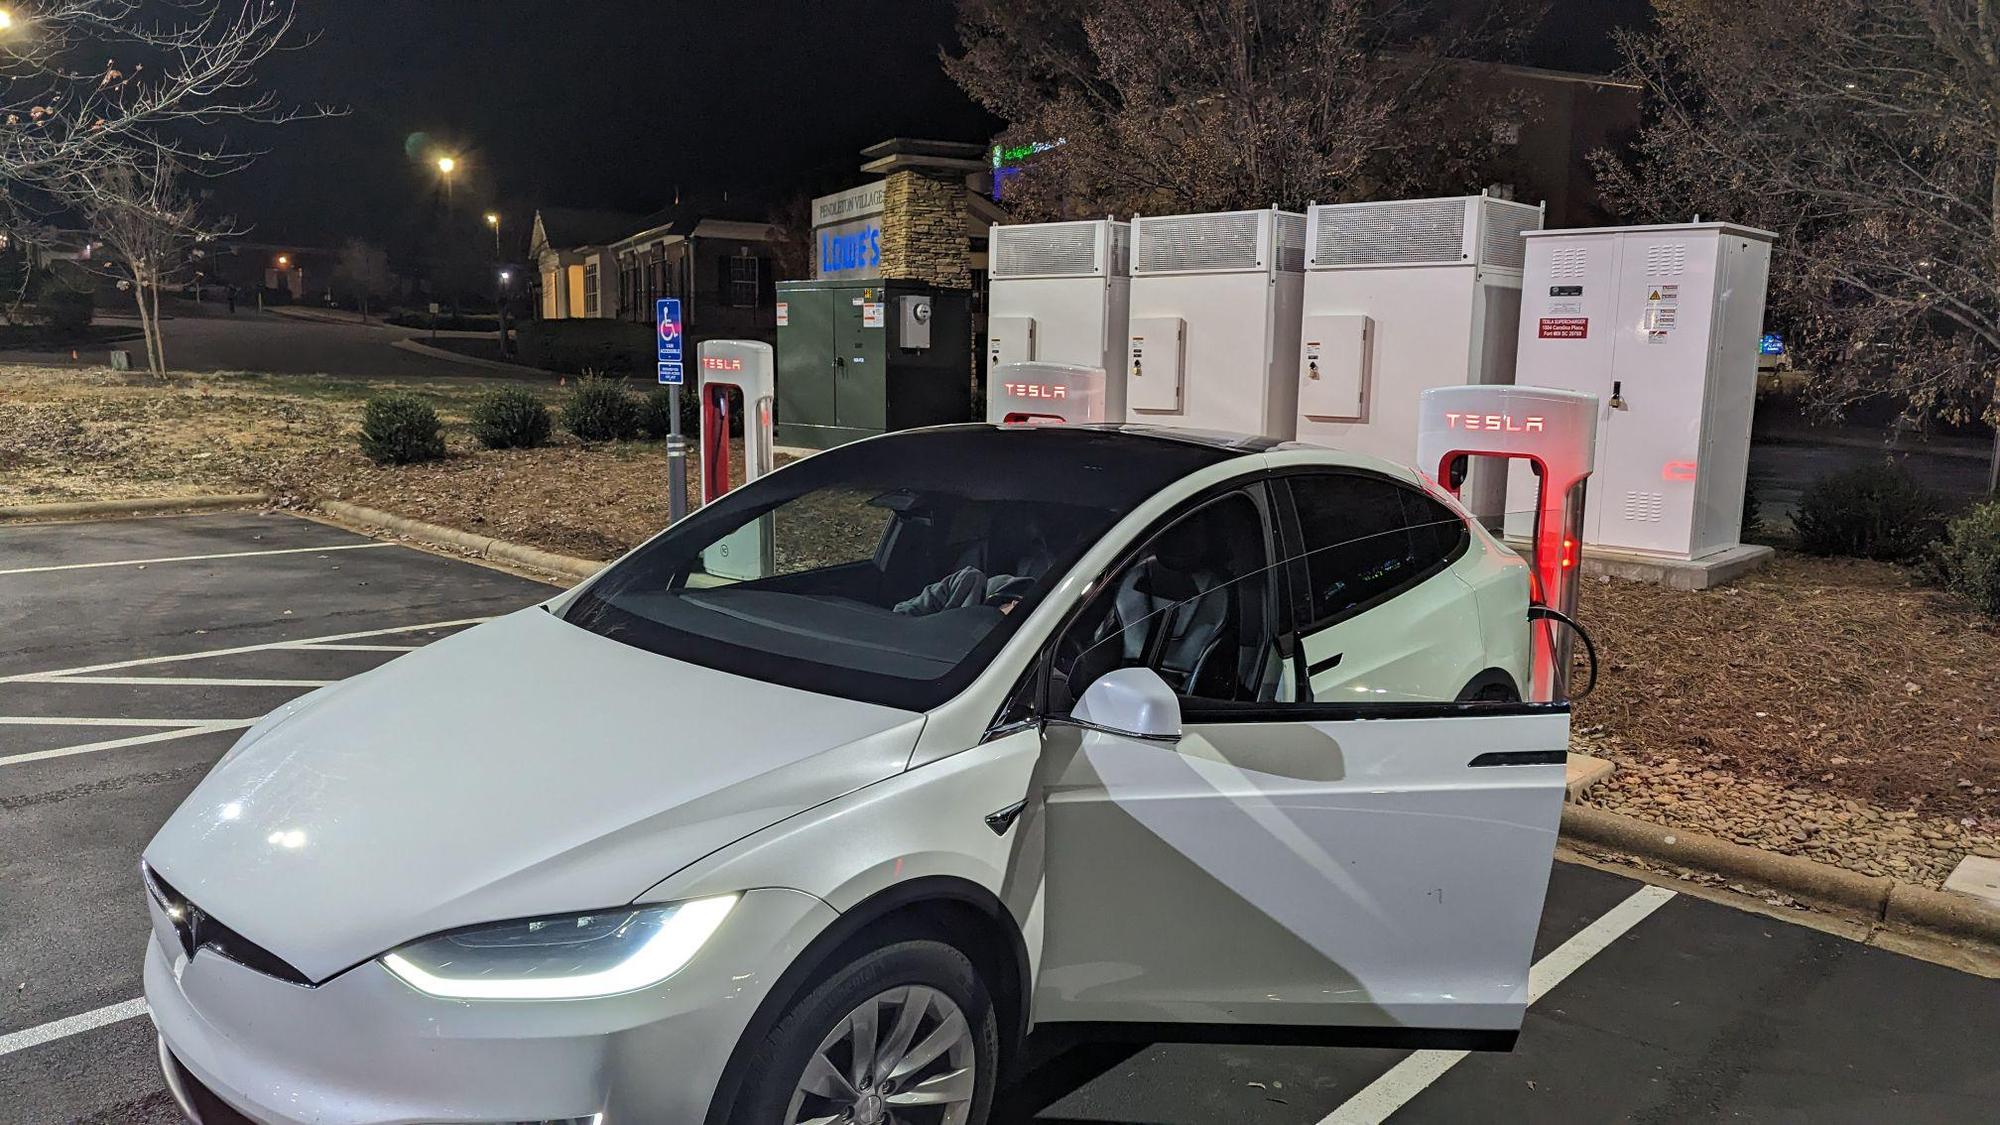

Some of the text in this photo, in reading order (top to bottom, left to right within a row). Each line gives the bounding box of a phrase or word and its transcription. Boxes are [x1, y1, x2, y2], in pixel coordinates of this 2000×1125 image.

[819, 190, 884, 218] PENDLETON VILLAGE
[822, 224, 881, 272] LOWE'S
[703, 358, 741, 370] TESLA
[1005, 383, 1066, 398] TESLA
[1446, 414, 1544, 432] TESLA
